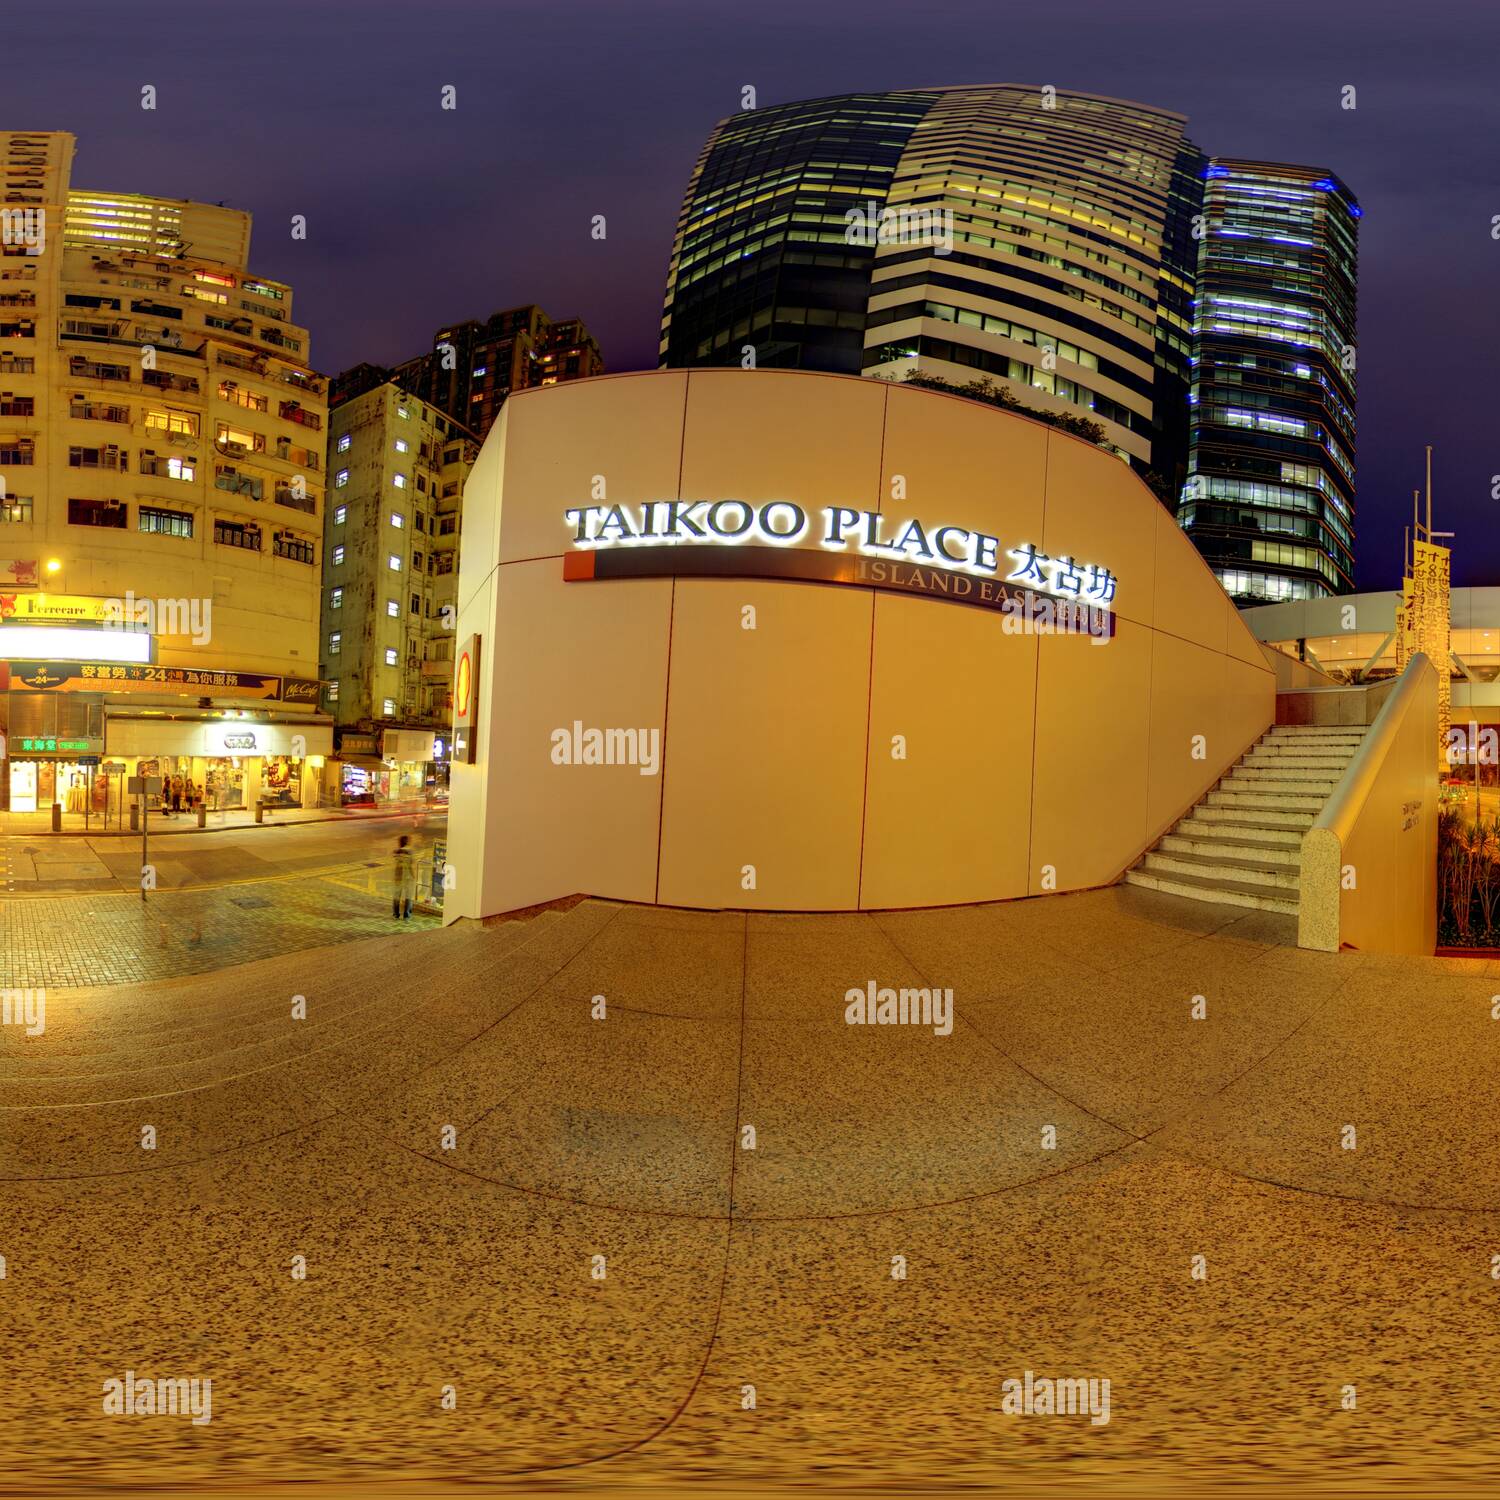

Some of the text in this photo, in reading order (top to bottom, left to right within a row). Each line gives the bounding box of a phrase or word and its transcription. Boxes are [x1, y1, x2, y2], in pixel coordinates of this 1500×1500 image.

[565, 500, 1118, 603] TAIKOO PLACE 太古坊
[858, 560, 972, 595] ISLAND
[980, 582, 1042, 611] EAST
